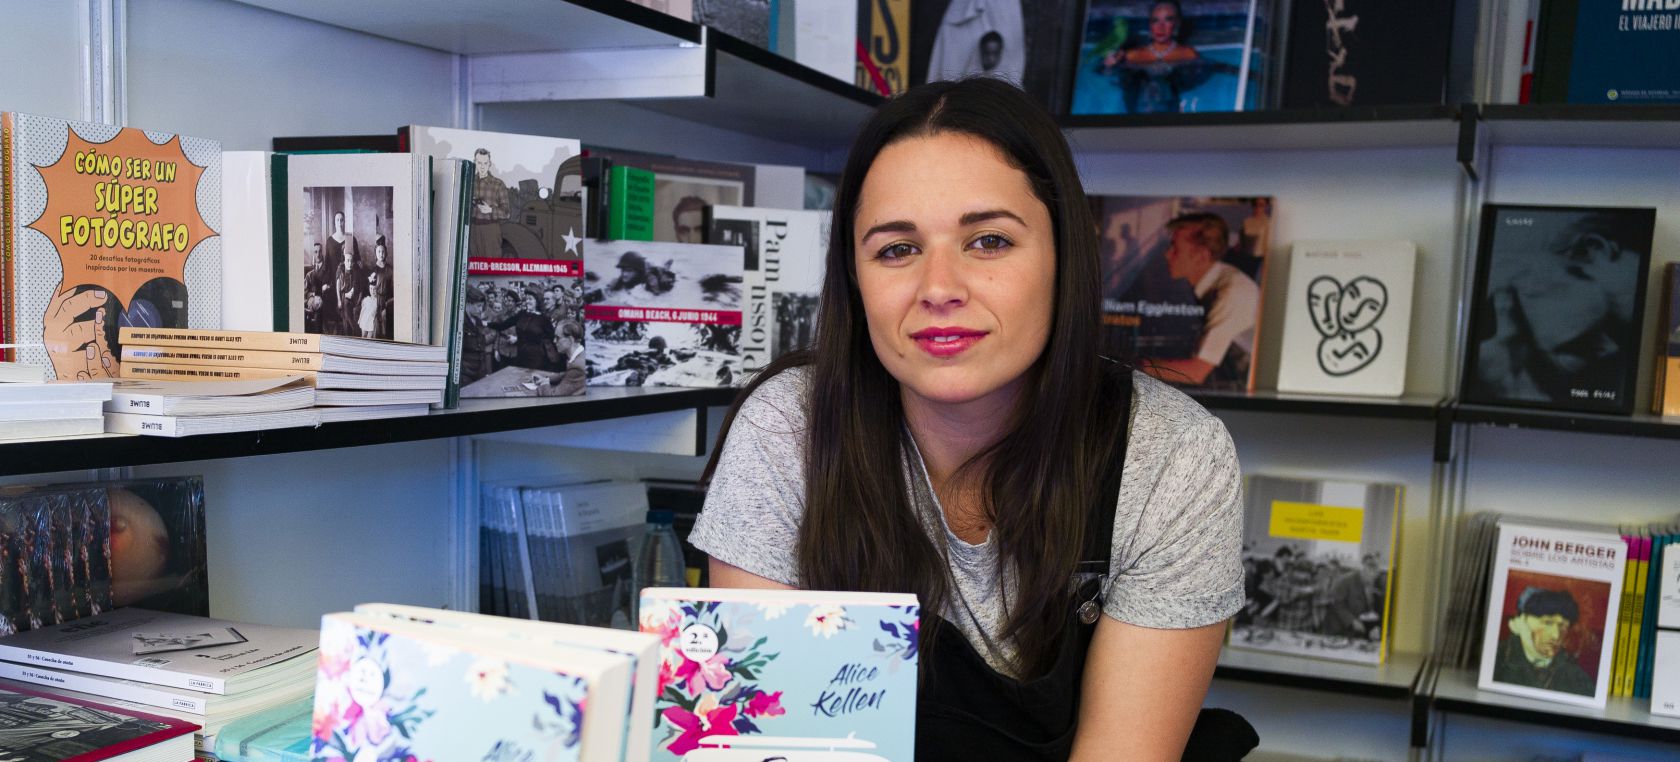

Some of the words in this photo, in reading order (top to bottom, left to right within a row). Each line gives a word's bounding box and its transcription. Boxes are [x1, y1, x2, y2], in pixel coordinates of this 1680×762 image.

[1618, 14, 1630, 31] EL
[1632, 14, 1672, 31] VIAJERO
[75, 148, 122, 176] CÓMO
[126, 158, 152, 180] SER
[155, 160, 176, 182] UN
[94, 178, 158, 216] SÚPER
[60, 210, 190, 253] FOTÓGRAFO
[124, 256, 160, 264] fotográficos
[765, 220, 788, 281] Pam
[468, 262, 521, 272] RTIER-BRESSON,
[522, 263, 553, 272] ALEMANIA
[554, 264, 568, 273] 1945
[618, 309, 644, 318] OMAHA
[646, 310, 671, 320] BEACH,
[672, 311, 677, 320] 6
[678, 311, 699, 321] JUNIO
[701, 312, 717, 322] 1944
[1104, 298, 1136, 313] lliam
[1138, 300, 1205, 317] Eggleston
[142, 422, 162, 430] BLUME
[1512, 536, 1550, 550] JOHN
[1554, 541, 1616, 560] BERGER
[1548, 553, 1568, 562] LOS
[1570, 557, 1615, 569] ARTISTAS
[830, 664, 878, 686] Alice
[810, 688, 886, 717] Kellen
